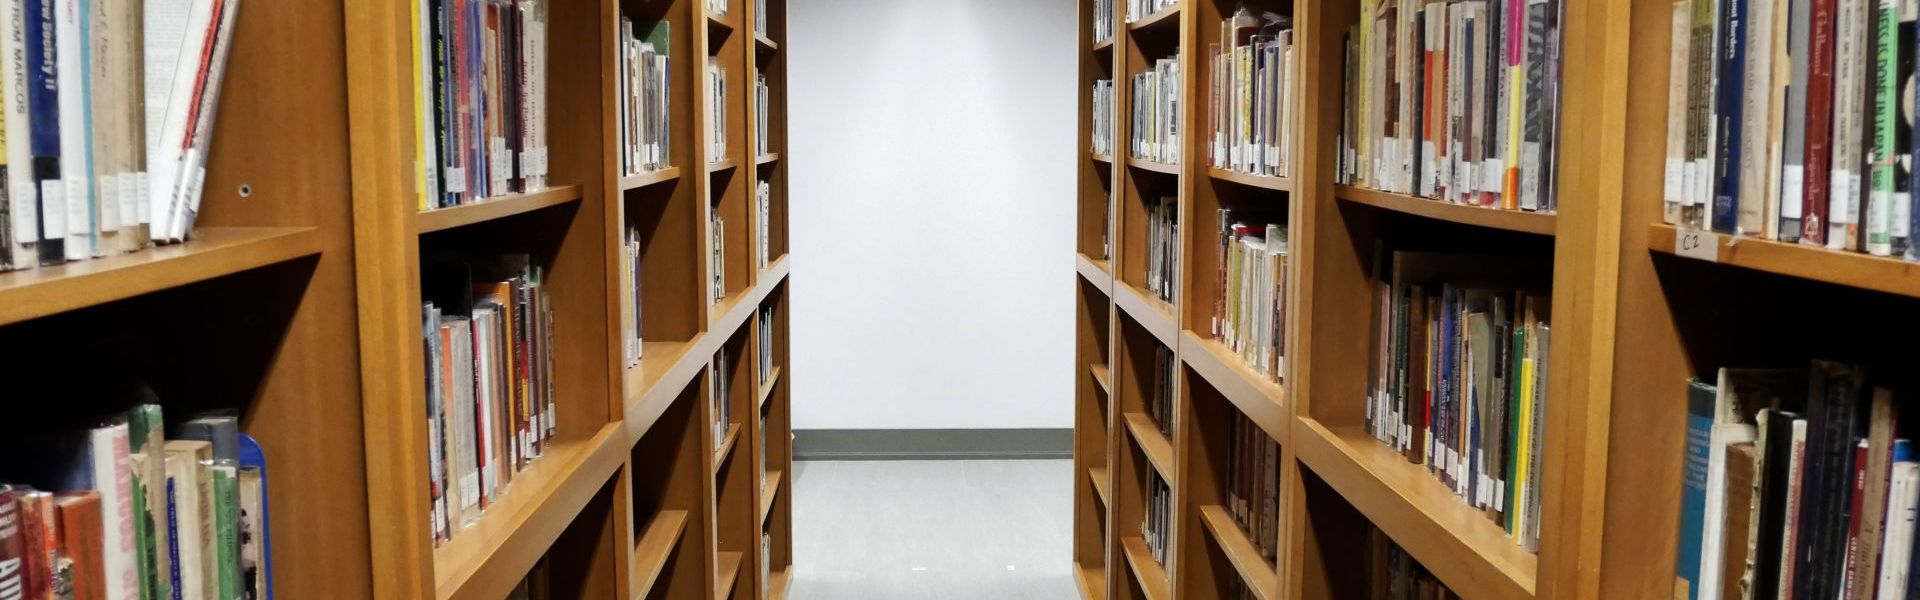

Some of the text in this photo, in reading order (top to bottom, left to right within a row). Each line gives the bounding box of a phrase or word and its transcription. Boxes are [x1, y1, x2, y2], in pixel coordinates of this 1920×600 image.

[42, 21, 54, 73] Society
[1729, 20, 1739, 59] Borders
[1878, 43, 1889, 55] IS
[15, 48, 25, 114] MARCOS
[45, 79, 55, 90] II
[1499, 68, 1507, 97] FEAR
[1877, 59, 1888, 96] DONE
[1876, 101, 1886, 115] IN
[1873, 119, 1884, 162] JAPAN
[112, 436, 136, 552] MARCOS
